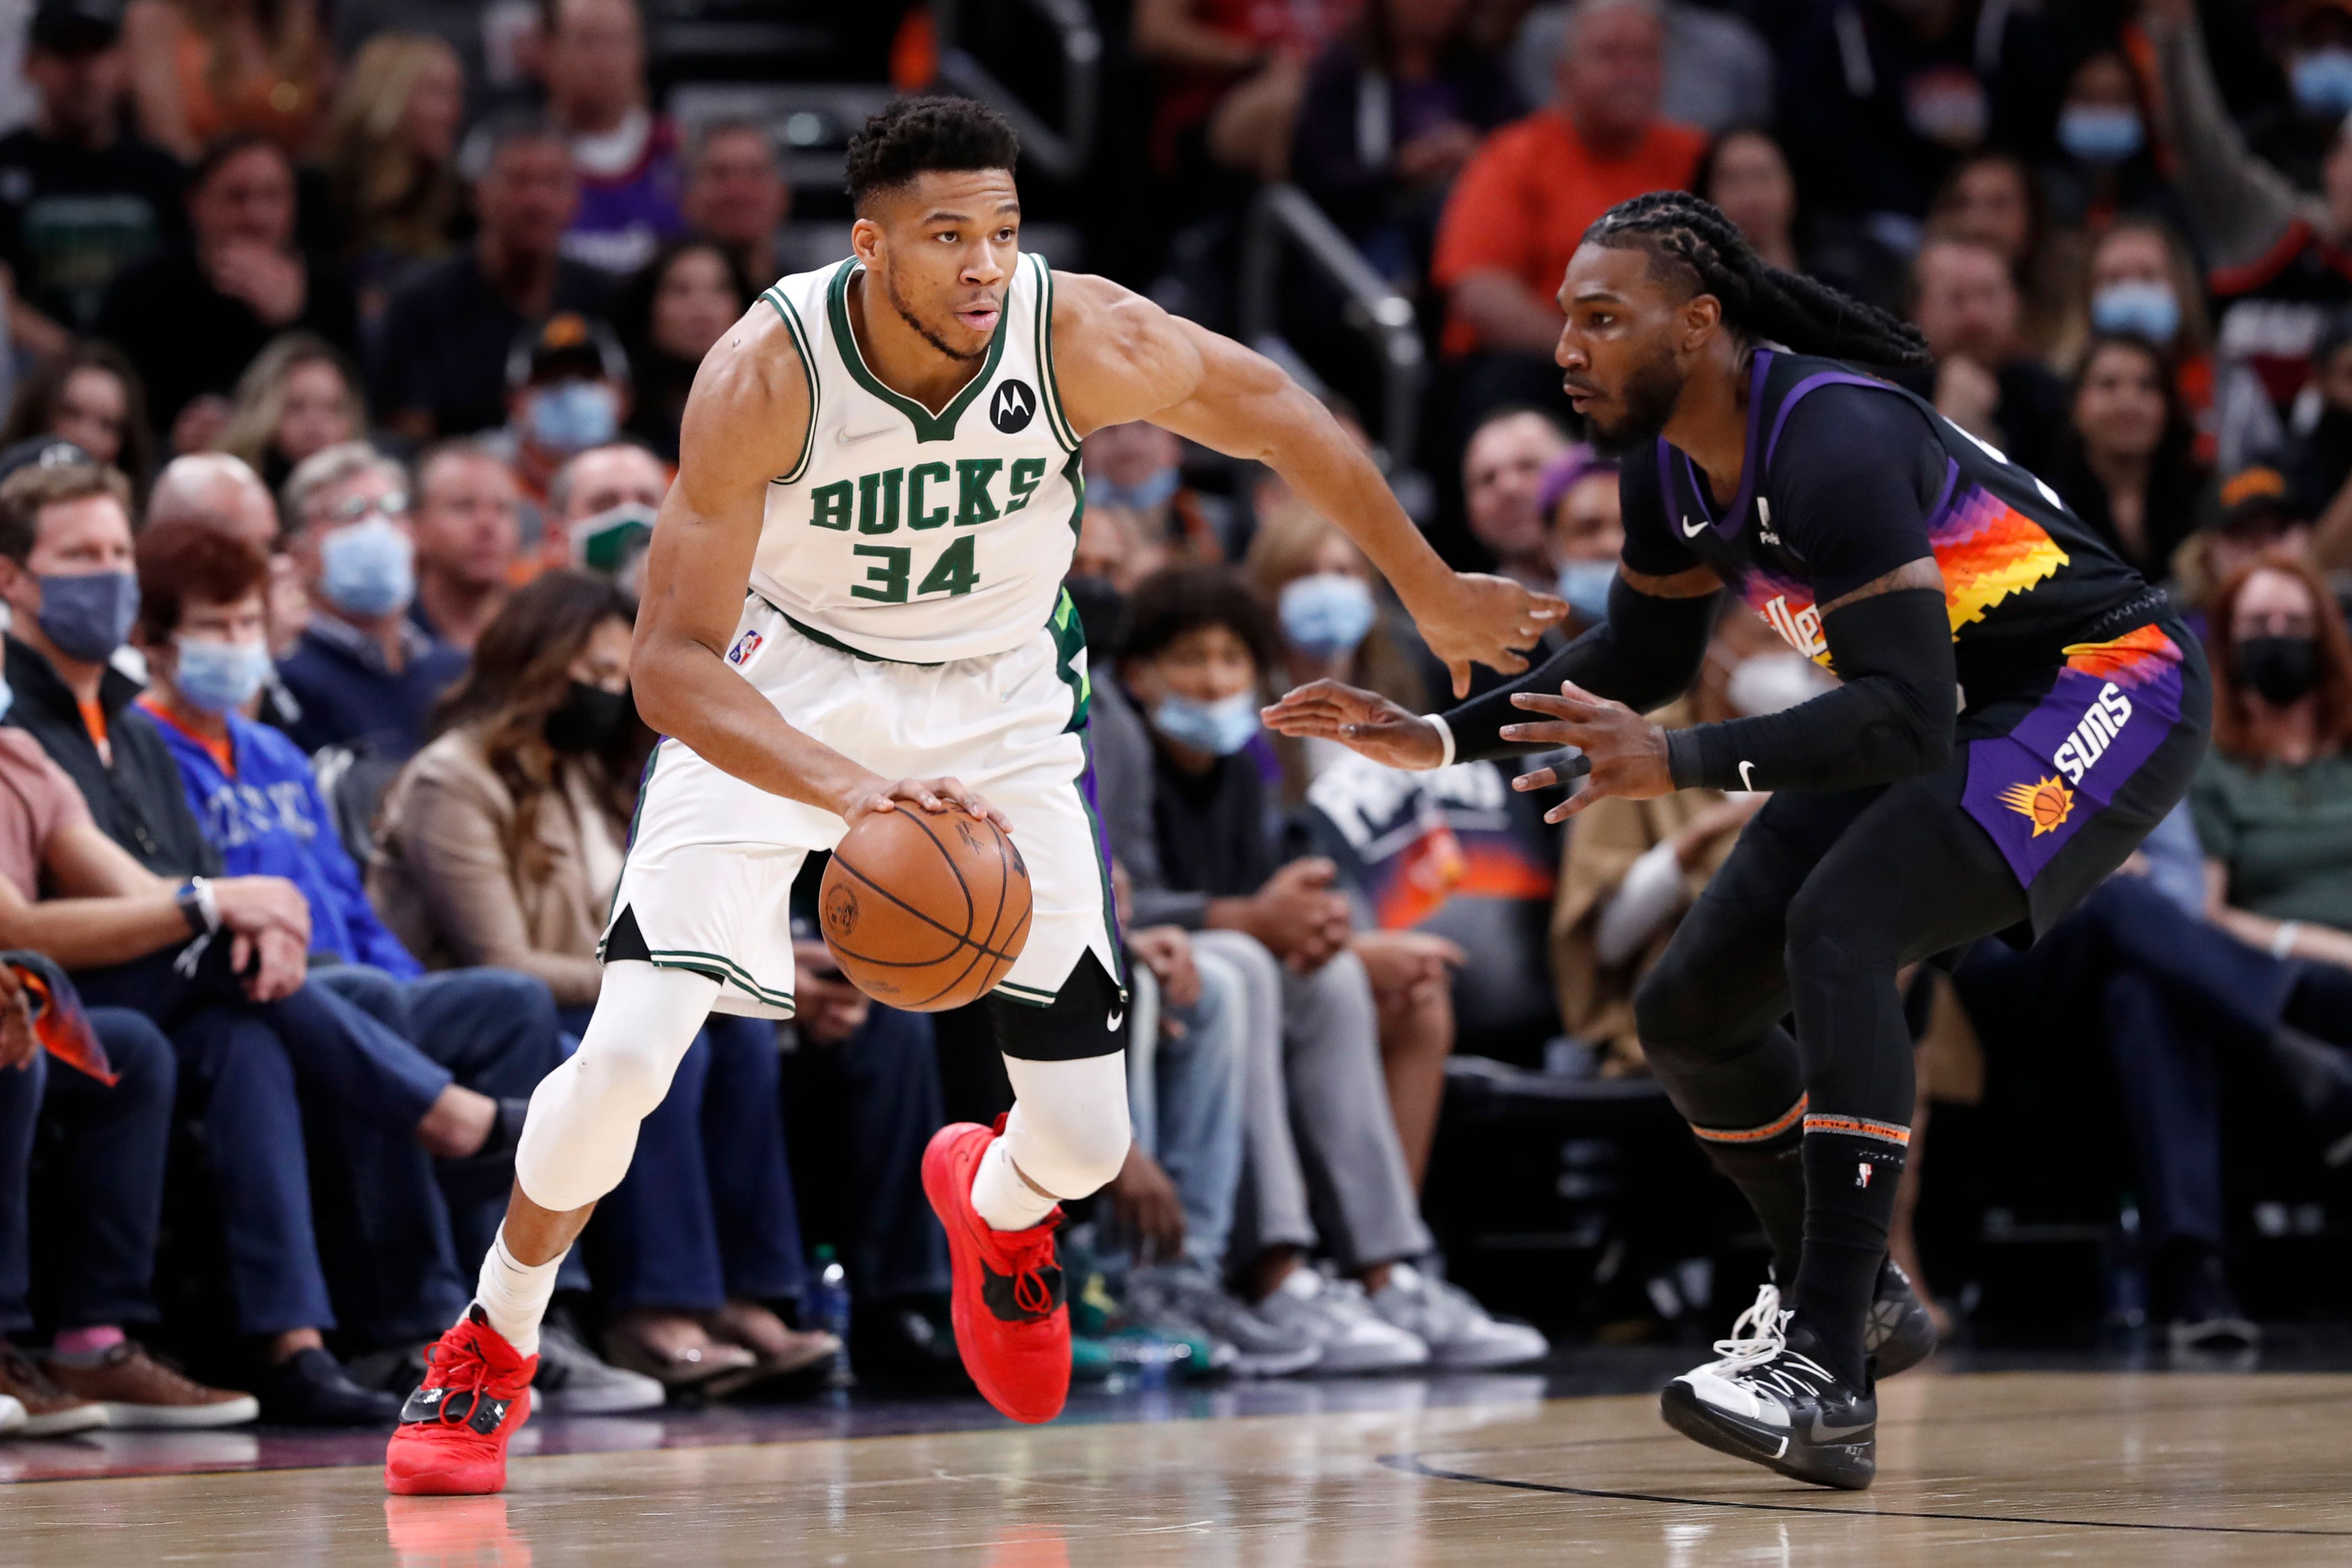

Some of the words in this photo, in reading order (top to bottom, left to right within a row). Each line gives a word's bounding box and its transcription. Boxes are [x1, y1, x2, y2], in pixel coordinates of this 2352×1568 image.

[809, 457, 1046, 535] BUCKS
[850, 534, 980, 603] 34
[2053, 682, 2133, 786] SUNS
